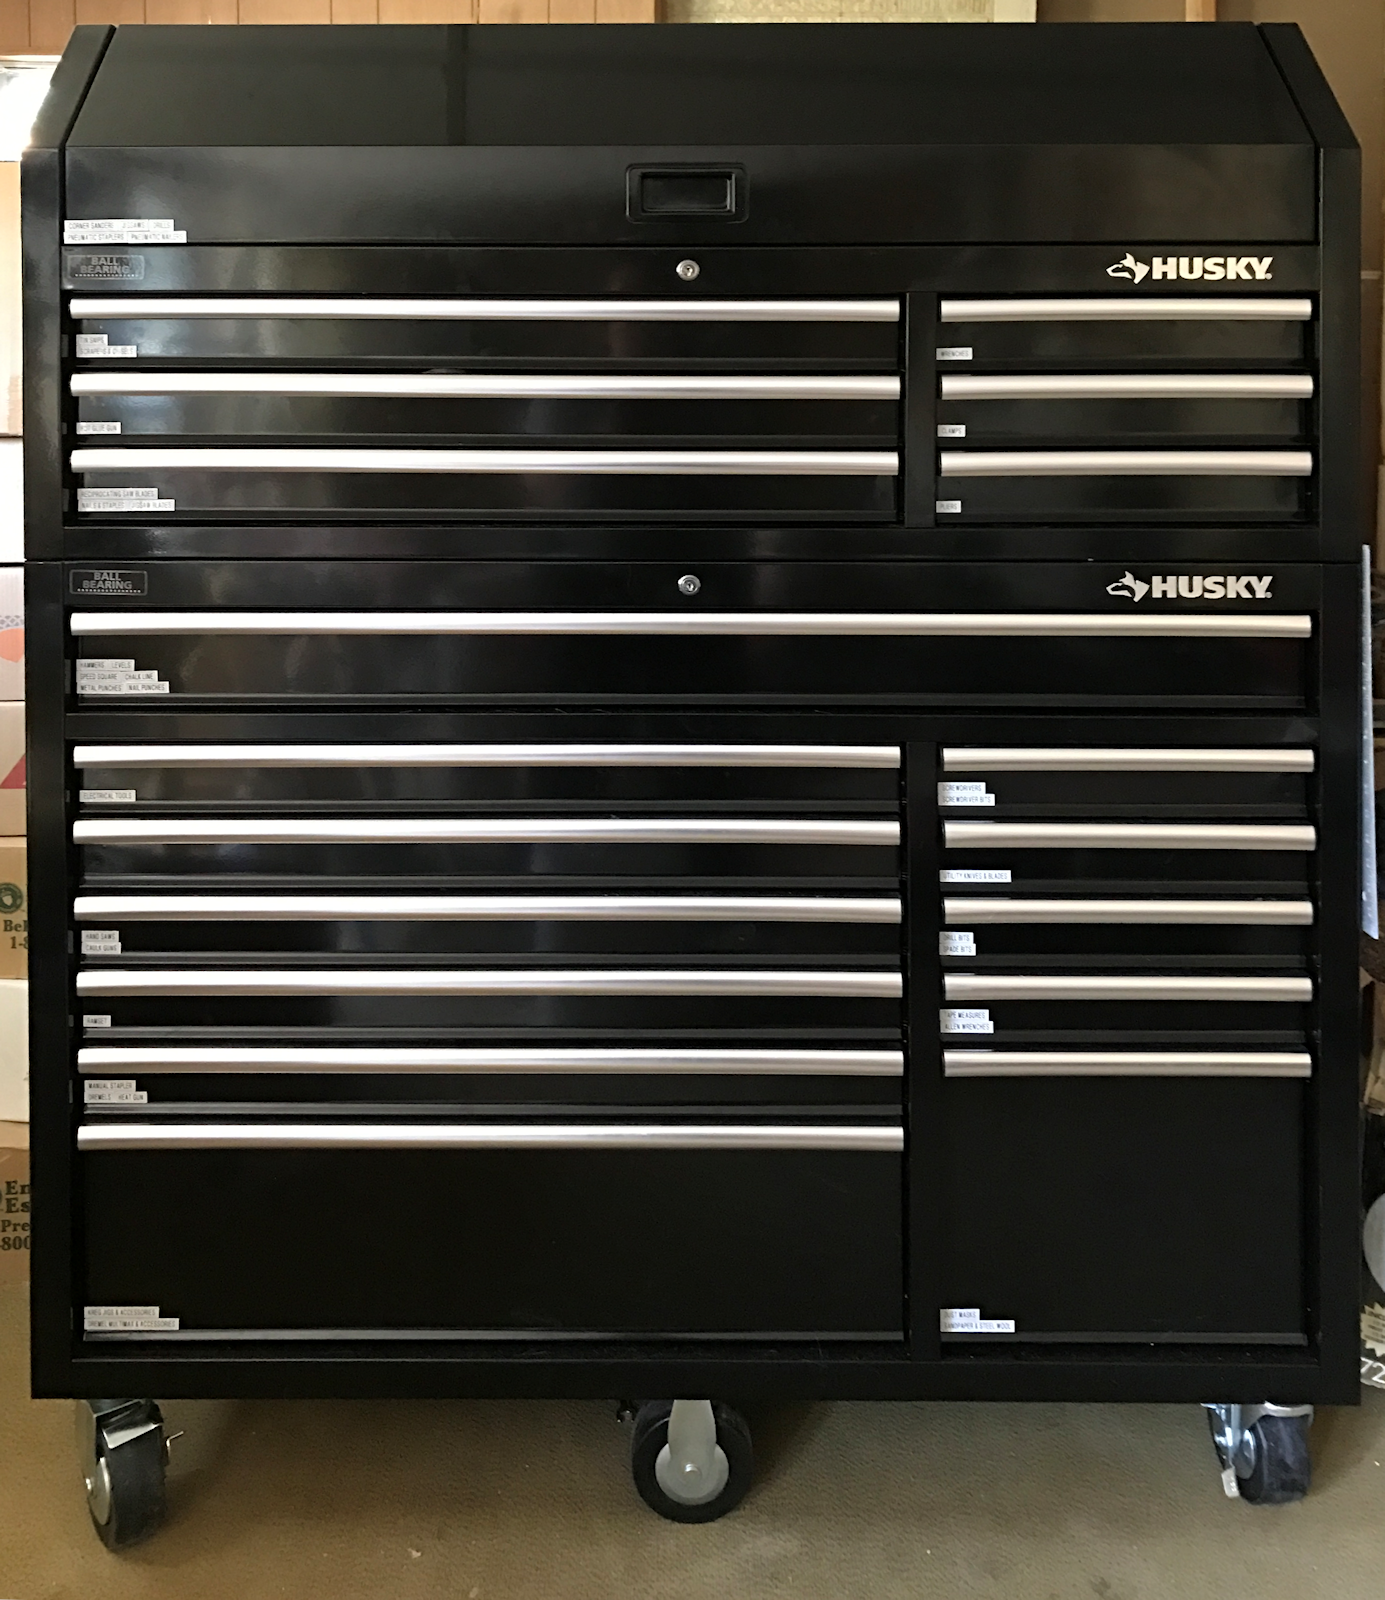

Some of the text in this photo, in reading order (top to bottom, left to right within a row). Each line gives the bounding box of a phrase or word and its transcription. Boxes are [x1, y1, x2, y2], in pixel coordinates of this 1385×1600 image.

[68, 222, 90, 230] CORNER
[91, 257, 119, 266] BALL
[80, 265, 130, 274] BEARING
[1152, 256, 1274, 280] HUSKY
[940, 350, 969, 358] WRENCHES
[94, 572, 122, 581] BALL
[82, 580, 132, 589] BEARING
[1152, 576, 1273, 600] HUSKY
[942, 784, 982, 792] SCREWDRIVERS
[83, 792, 132, 800] ELECTRICAL TOOLS
[964, 872, 982, 880] KNIVES
[988, 872, 1008, 880] BLADES
[958, 934, 970, 942] BITS
[960, 945, 972, 953] BITS
[958, 1011, 986, 1019] MEASURES
[120, 1308, 156, 1316] ACCESSORIES
[996, 1322, 1011, 1330] WOOL
